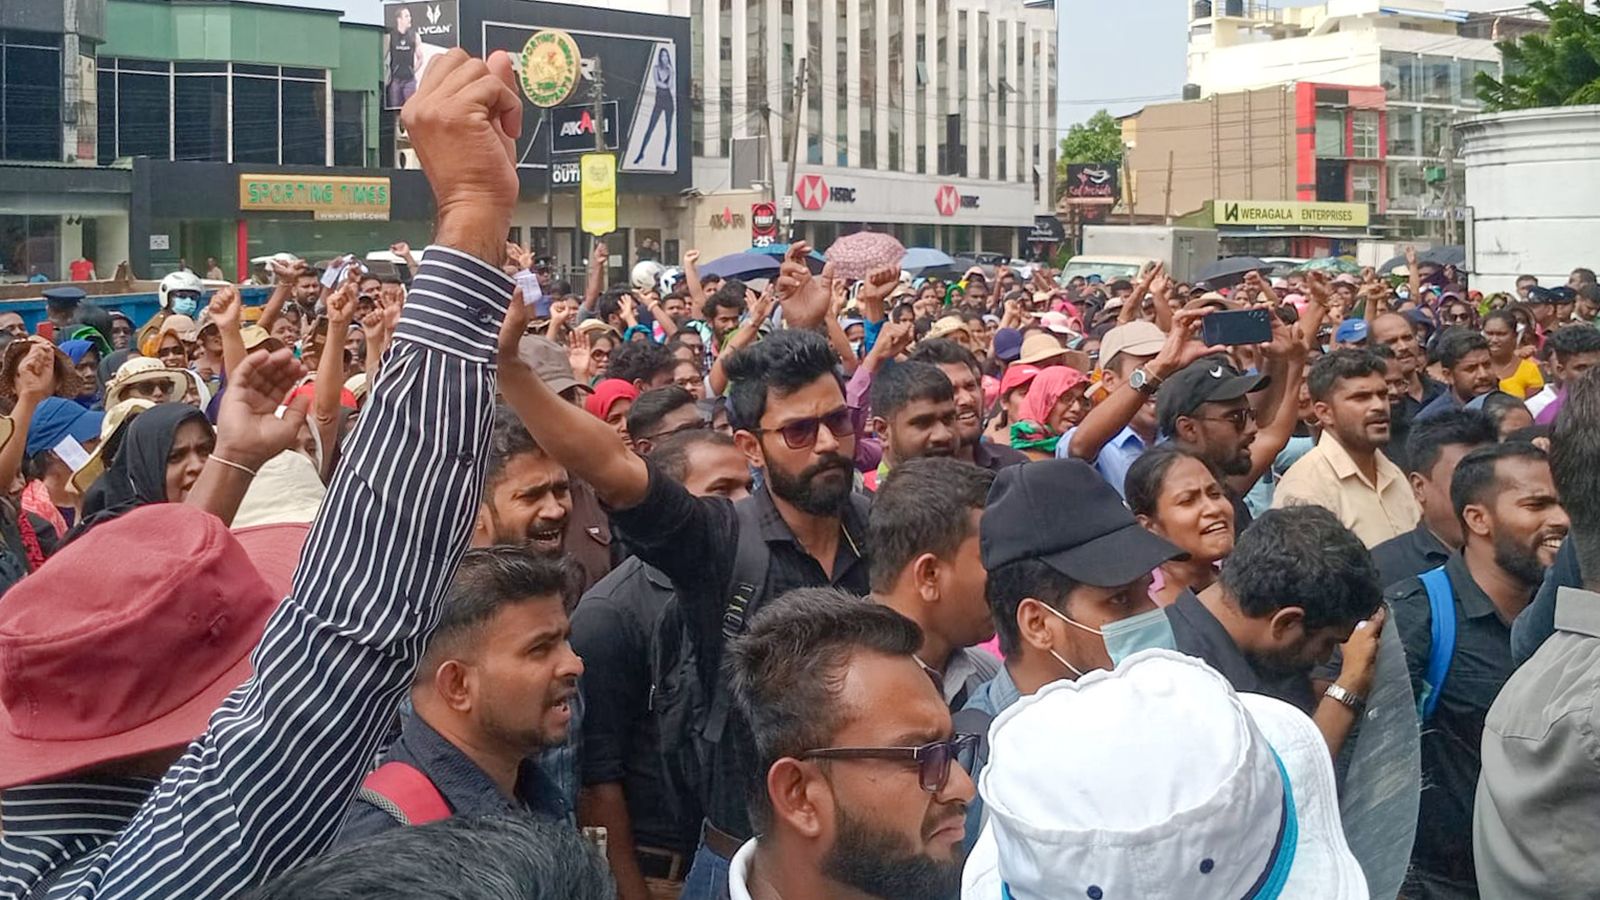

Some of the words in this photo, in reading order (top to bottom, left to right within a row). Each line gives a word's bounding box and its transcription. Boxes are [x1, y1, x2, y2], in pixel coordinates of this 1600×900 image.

[417, 25, 450, 34] LYCAN
[559, 110, 609, 136] AKAI
[247, 181, 334, 204] SPORTING
[340, 184, 388, 205] TIMES
[829, 186, 856, 203] HSBC
[1240, 208, 1294, 220] WERAGALA
[1301, 209, 1353, 222] ENTERPRISES
